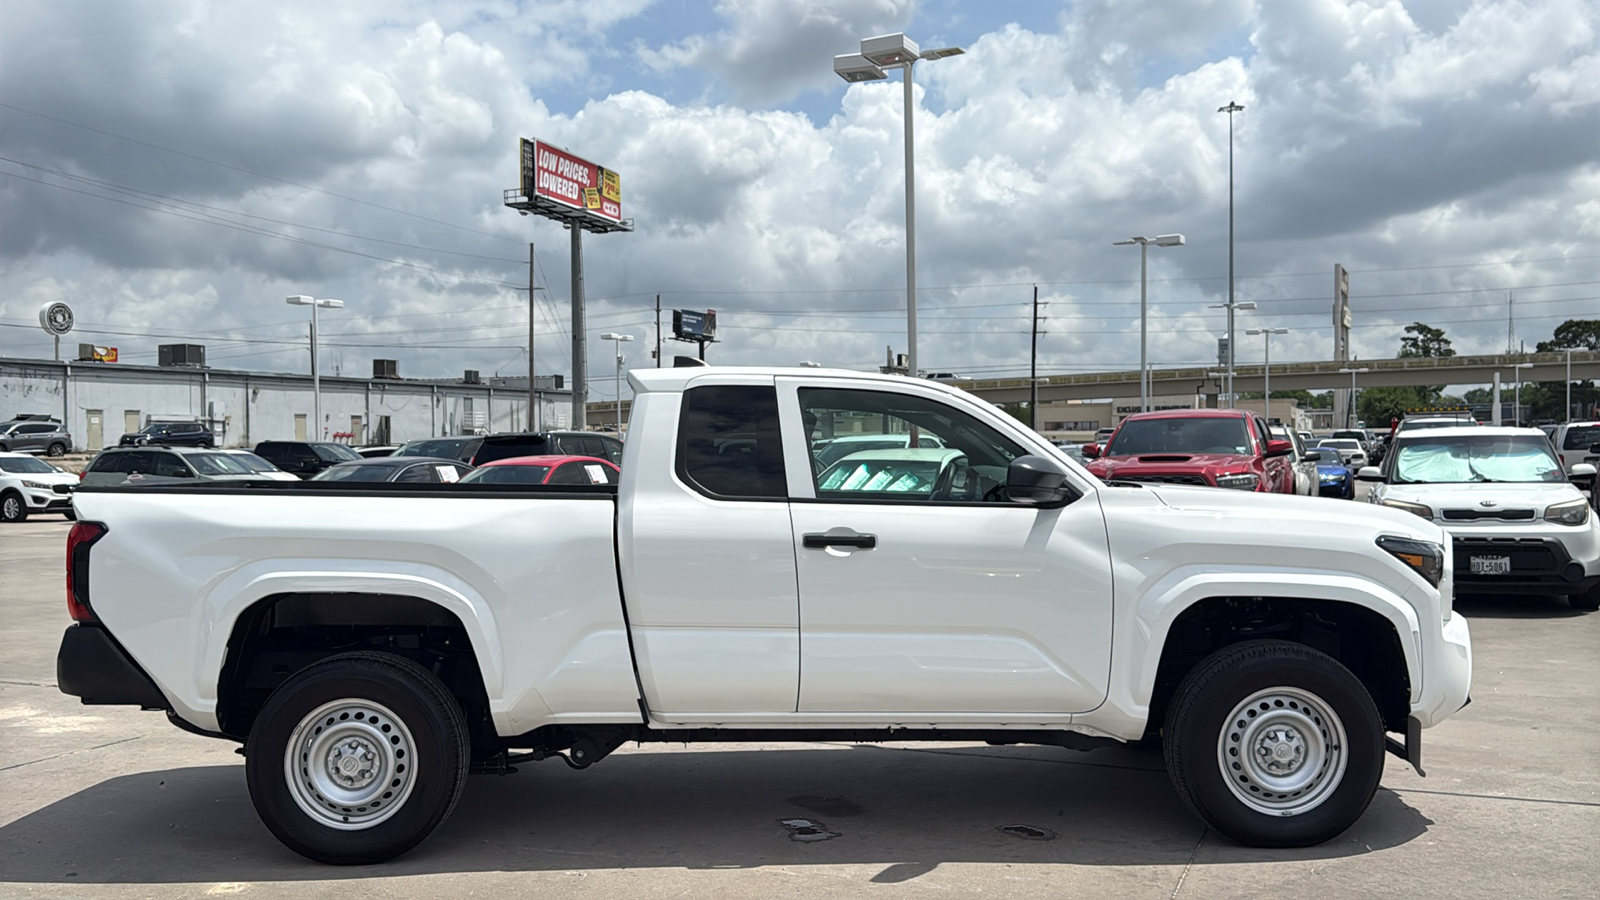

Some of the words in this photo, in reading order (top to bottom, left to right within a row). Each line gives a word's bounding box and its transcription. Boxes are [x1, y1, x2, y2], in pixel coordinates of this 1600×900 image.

[539, 149, 558, 172] LOW
[558, 157, 591, 187] PRICES,
[539, 170, 579, 200] LOWERED
[1117, 405, 1150, 413] EXCLUSE
